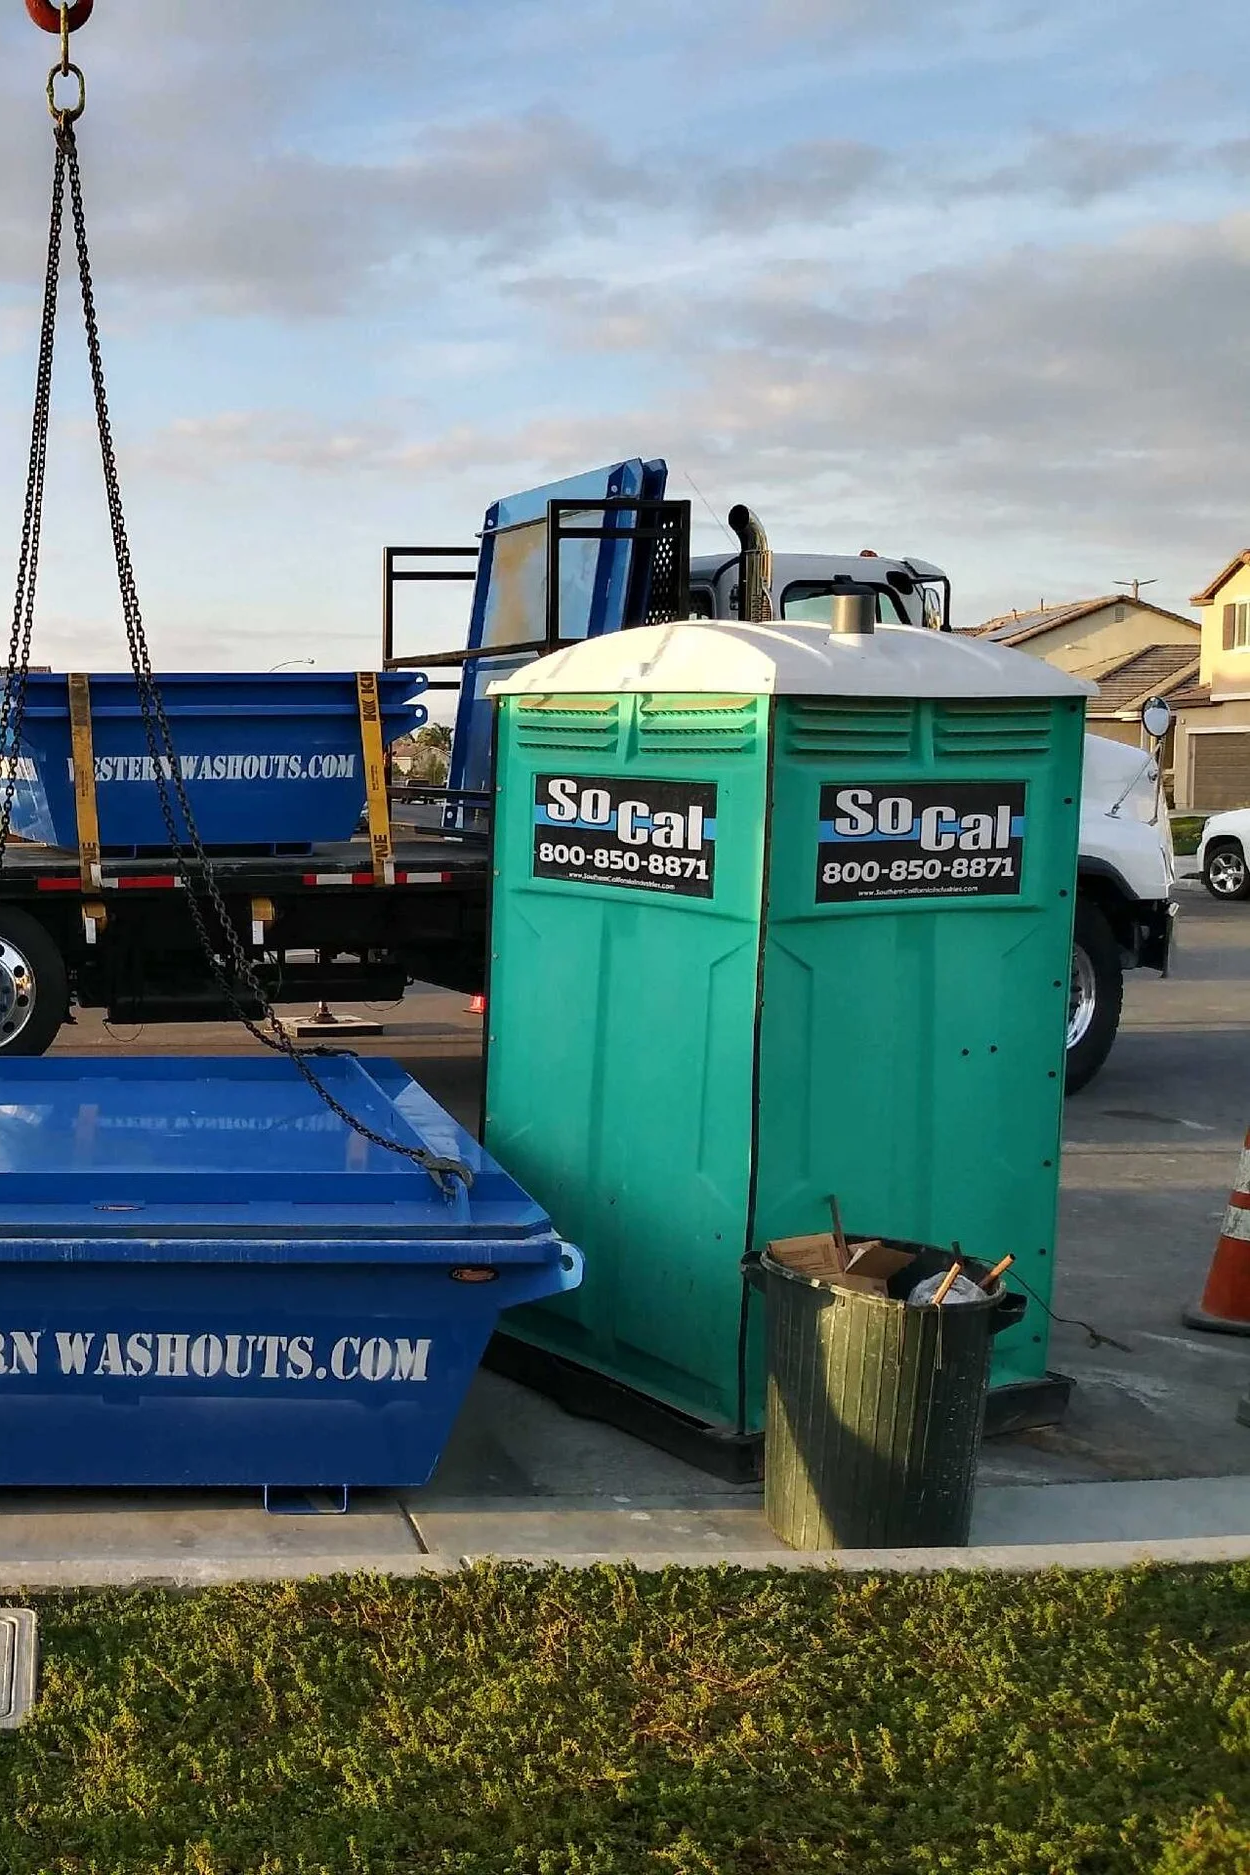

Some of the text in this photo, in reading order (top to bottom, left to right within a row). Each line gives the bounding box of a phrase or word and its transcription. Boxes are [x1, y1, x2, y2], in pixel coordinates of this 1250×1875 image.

[179, 754, 355, 780] WASHOUTS.COM
[539, 843, 709, 880] 800-850-8871
[822, 857, 1015, 884] 800-850-8871
[55, 1332, 431, 1382] WASHOUTS.COM
